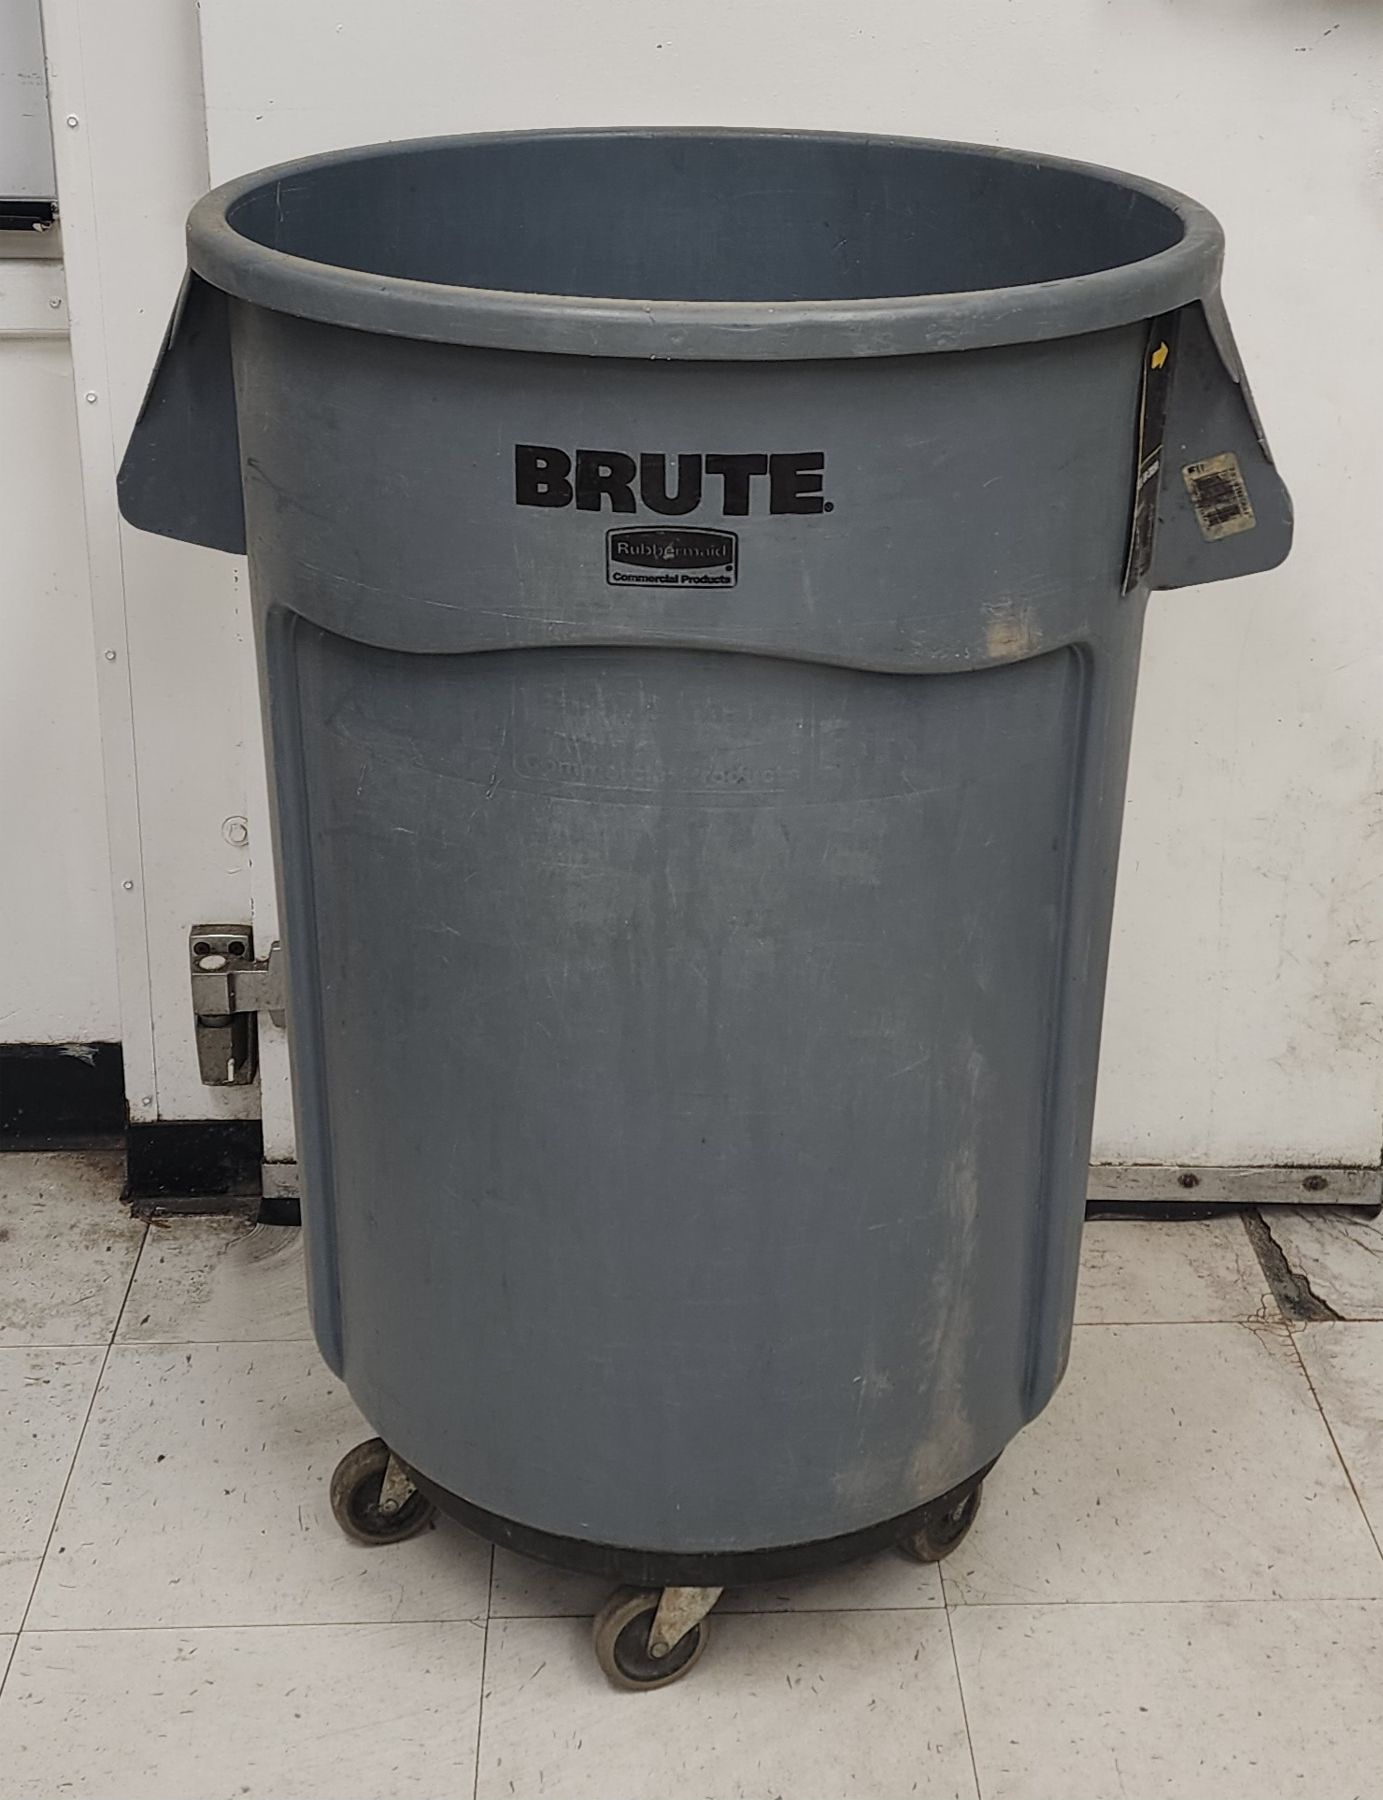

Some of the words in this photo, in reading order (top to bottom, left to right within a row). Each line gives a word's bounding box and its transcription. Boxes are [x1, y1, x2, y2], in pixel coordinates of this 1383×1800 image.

[515, 444, 825, 515] BRUTE
[612, 572, 679, 584] Commercial
[681, 574, 732, 585] Products
